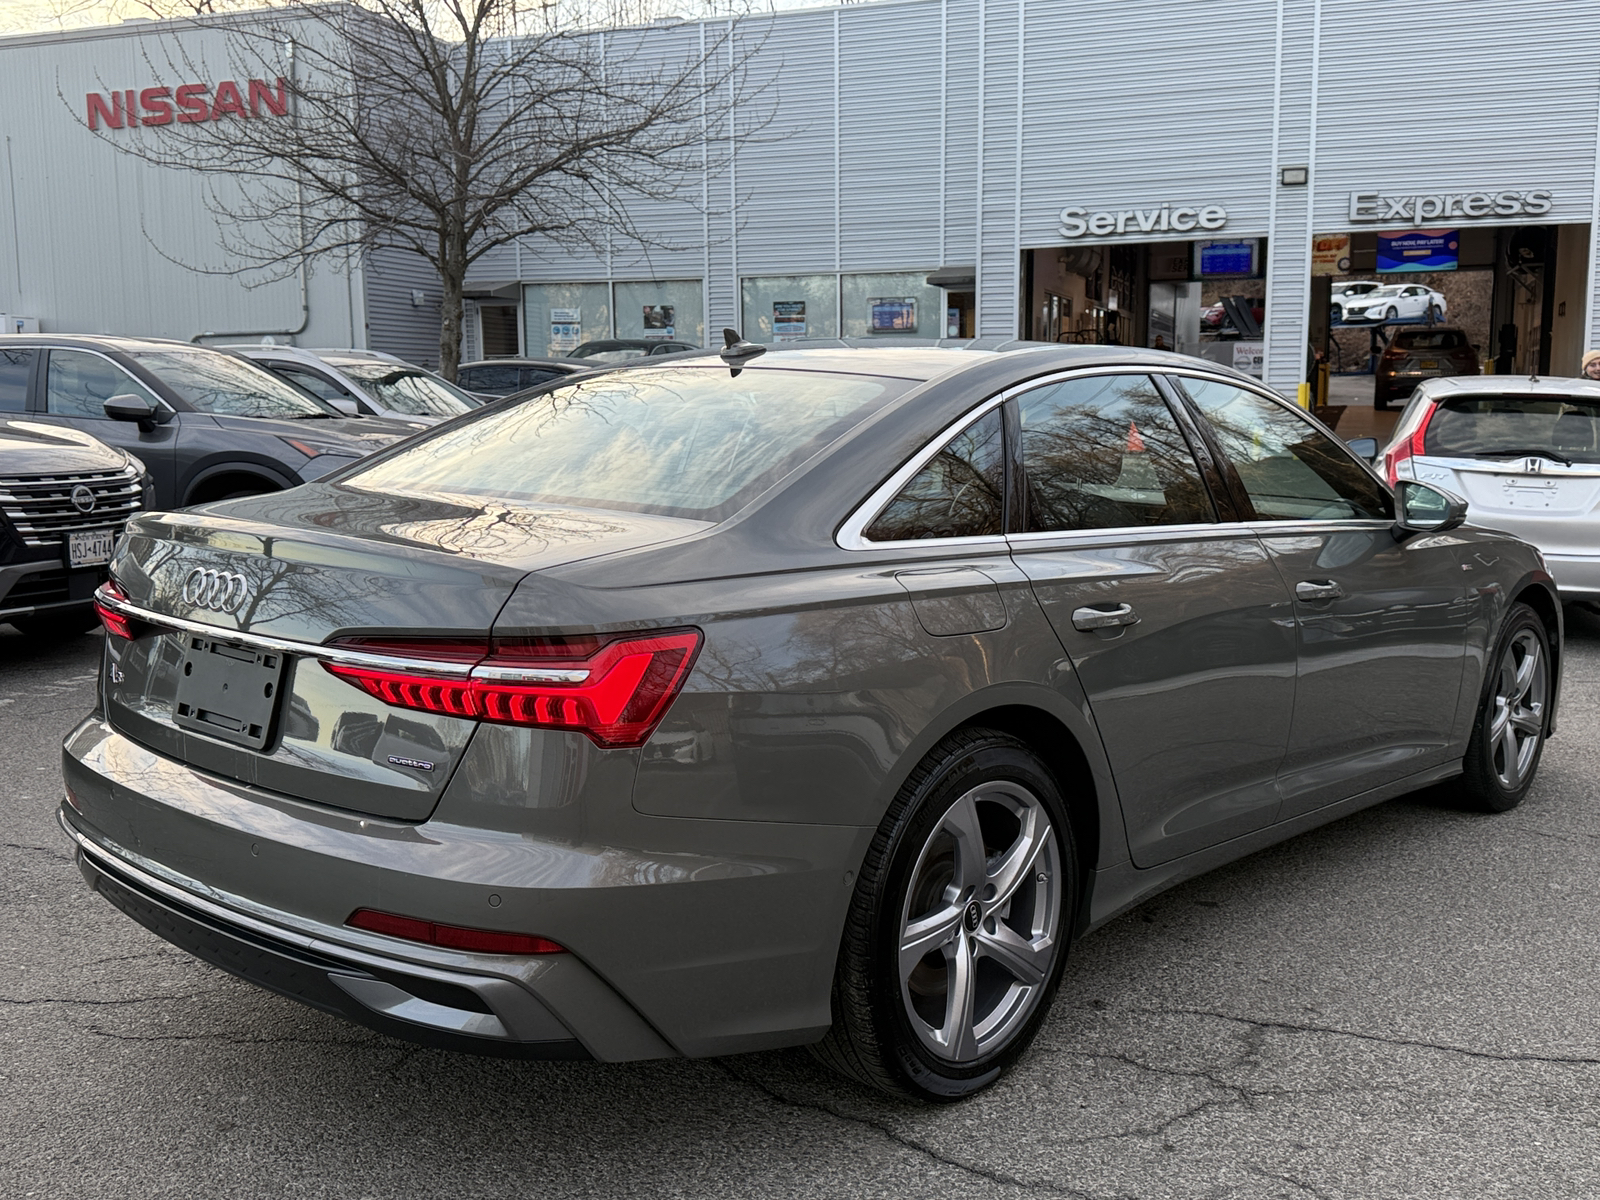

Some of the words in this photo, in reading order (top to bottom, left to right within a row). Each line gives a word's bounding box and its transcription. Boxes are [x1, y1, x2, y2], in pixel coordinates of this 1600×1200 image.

[86, 77, 288, 131] NISSAN
[1058, 203, 1227, 238] Service
[1349, 189, 1552, 226] Express
[71, 542, 88, 559] HSJ
[93, 539, 112, 556] 4744
[388, 756, 431, 769] quattro
